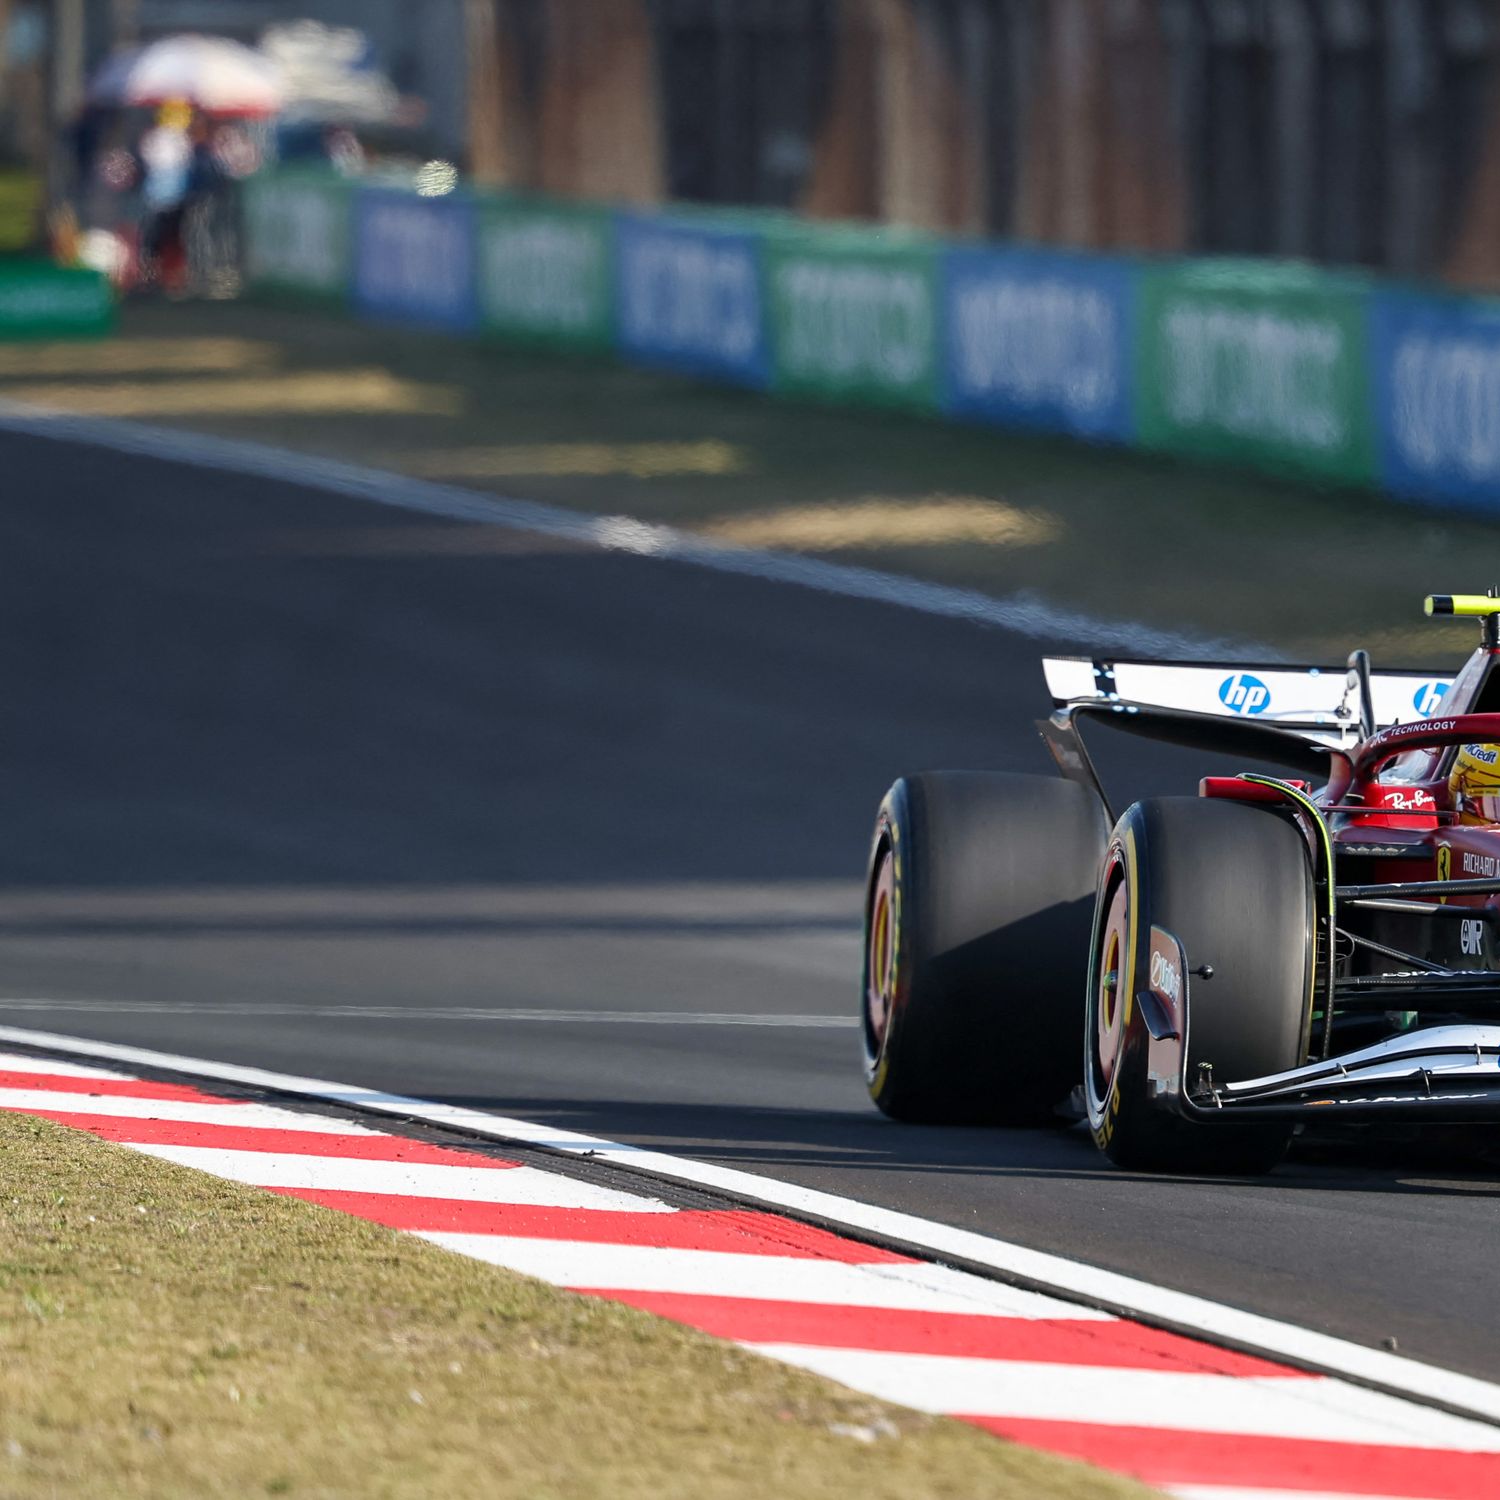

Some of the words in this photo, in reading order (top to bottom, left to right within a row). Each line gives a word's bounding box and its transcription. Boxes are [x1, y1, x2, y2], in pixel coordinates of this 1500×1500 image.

[1221, 674, 1269, 716] hp
[1390, 721, 1456, 737] TECHNOLOGY
[1384, 790, 1436, 810] Ray-Ban
[1463, 853, 1494, 877] RICHARD
